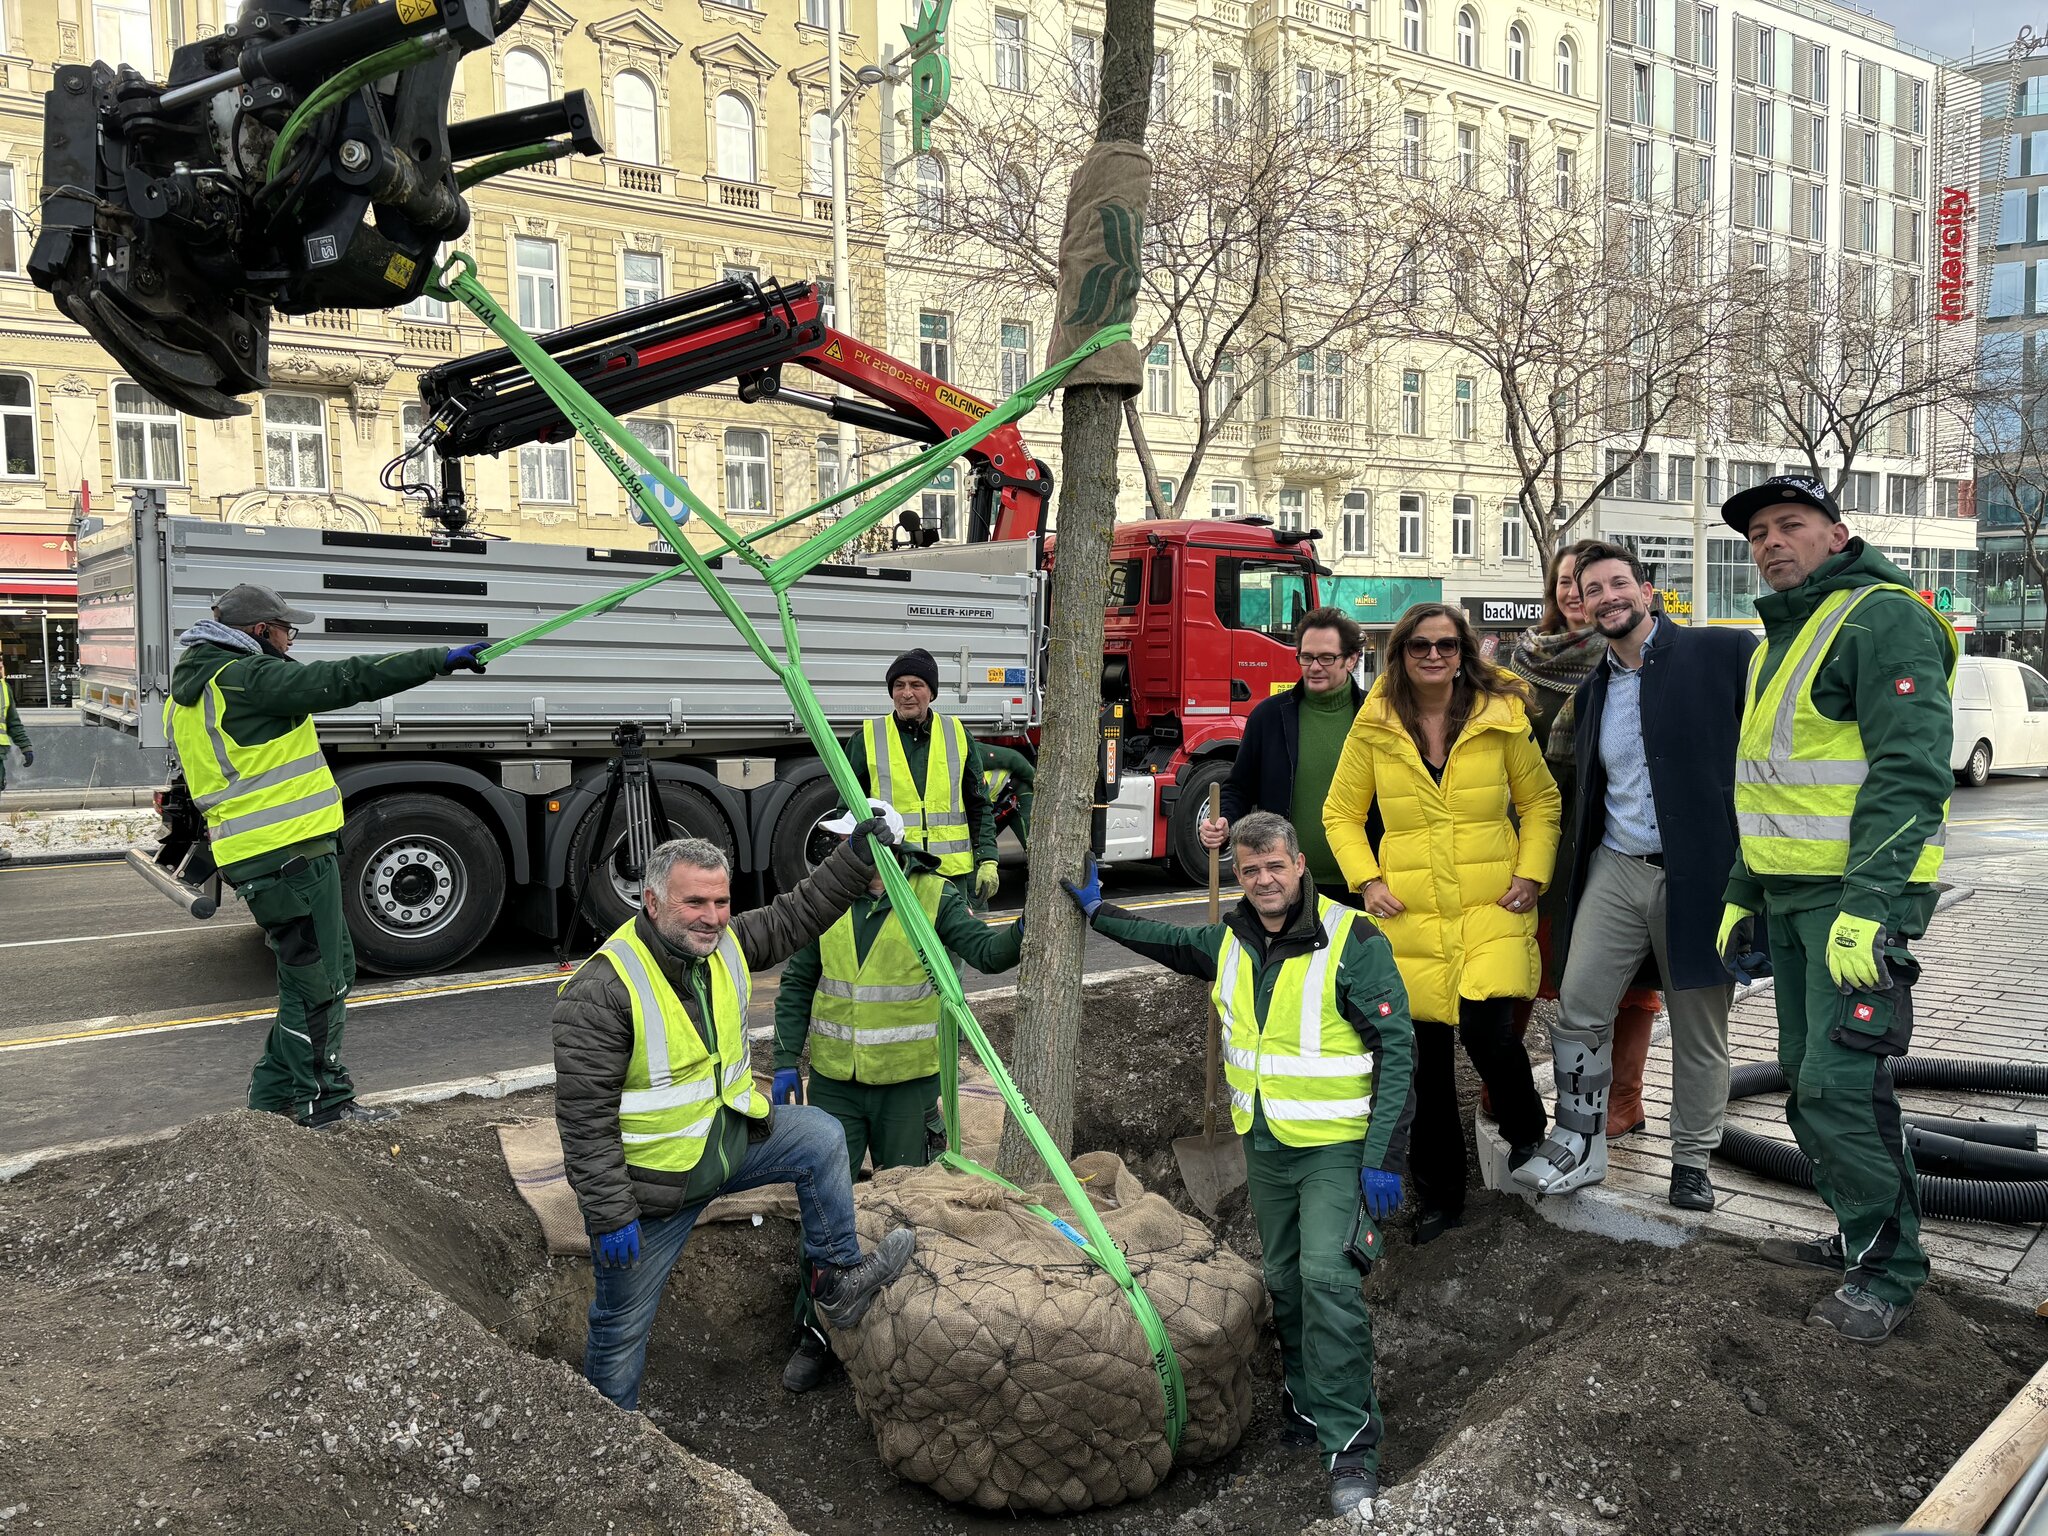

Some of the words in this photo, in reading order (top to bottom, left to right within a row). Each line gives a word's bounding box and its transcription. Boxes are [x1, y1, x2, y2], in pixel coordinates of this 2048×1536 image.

[1936, 187, 1969, 323] Intercity
[854, 349, 870, 364] PK
[939, 388, 993, 419] PALFING
[909, 607, 992, 617] MEILLER-KIPPER
[1106, 816, 1139, 829] AN
[1155, 1348, 1169, 1380] WLL
[1163, 1384, 1175, 1407] 2000
